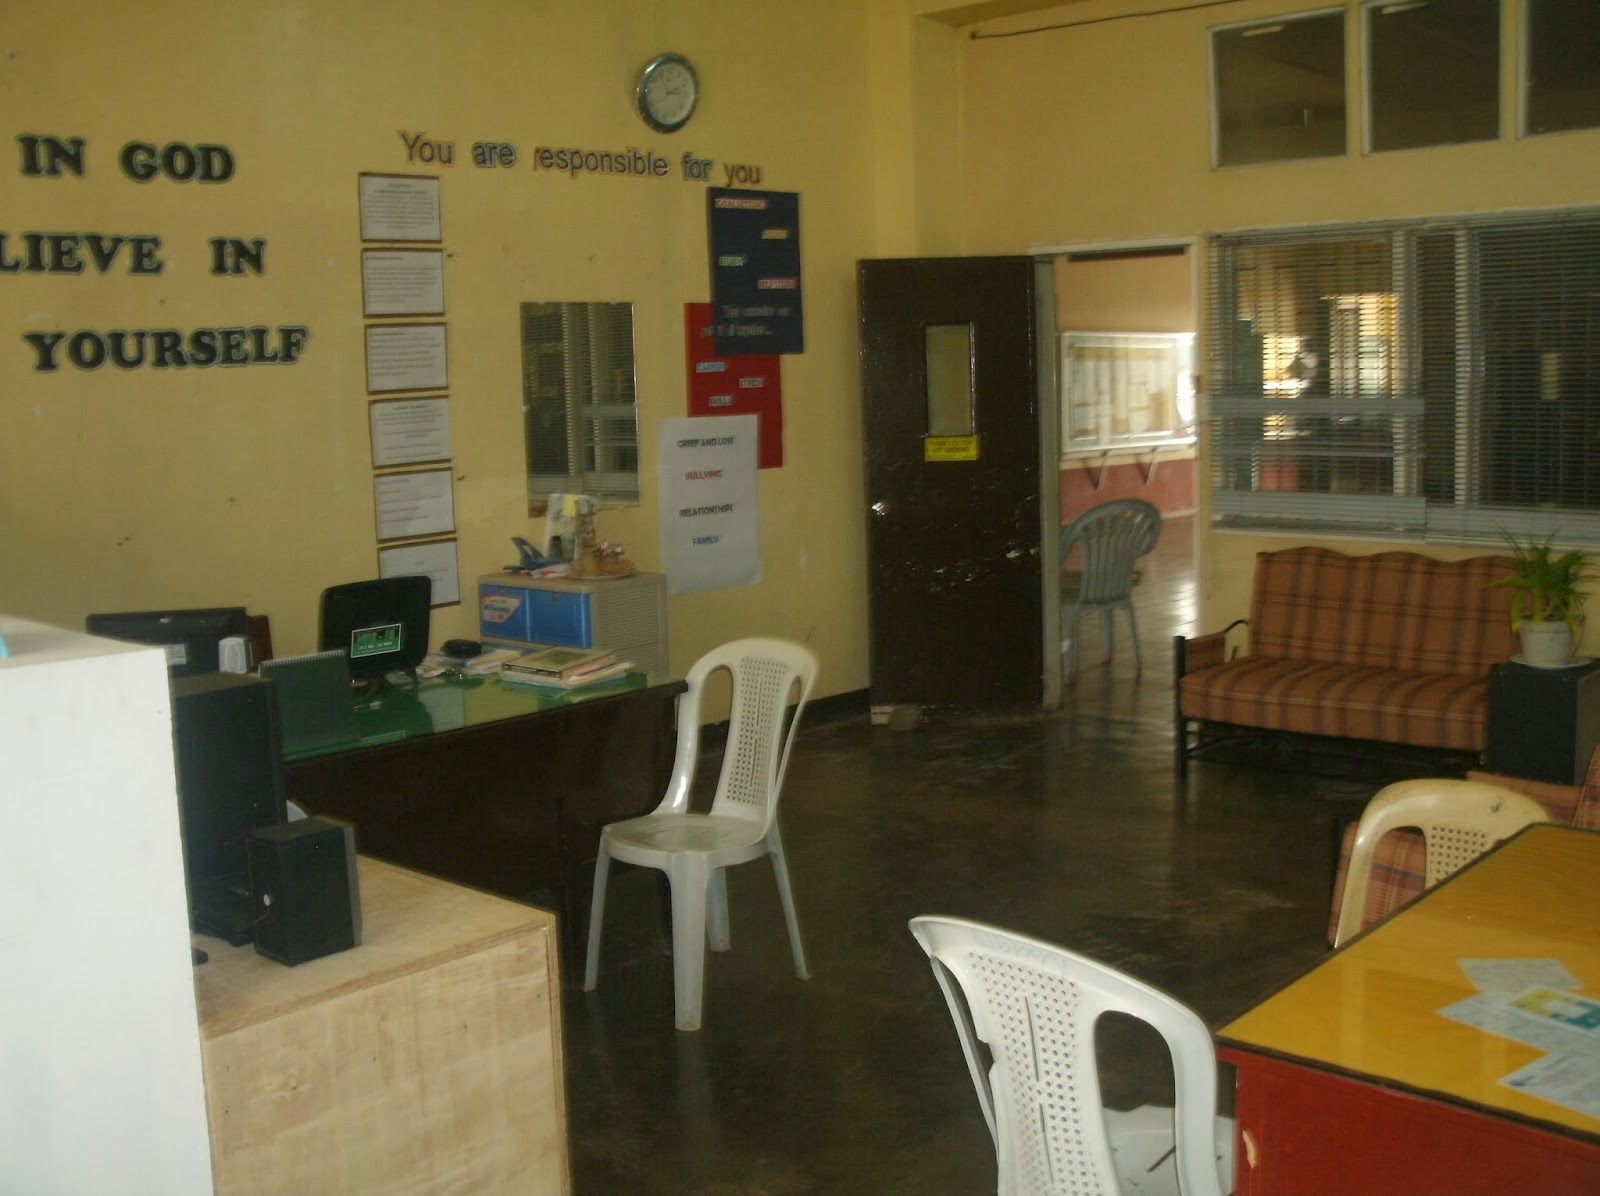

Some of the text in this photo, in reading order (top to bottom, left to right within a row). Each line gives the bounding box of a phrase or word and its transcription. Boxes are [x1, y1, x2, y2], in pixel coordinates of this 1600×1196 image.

[16, 134, 235, 183] IN GOD
[398, 129, 763, 187] You are responsible for you
[0, 231, 266, 276] LIEVE IN
[22, 326, 309, 373] YOURSELF
[677, 438, 699, 448] GRIEF
[701, 437, 717, 447] AND
[685, 470, 722, 480] BULLYING
[679, 503, 734, 517] RELATIONSHIPS
[692, 535, 720, 547] FAMILY
